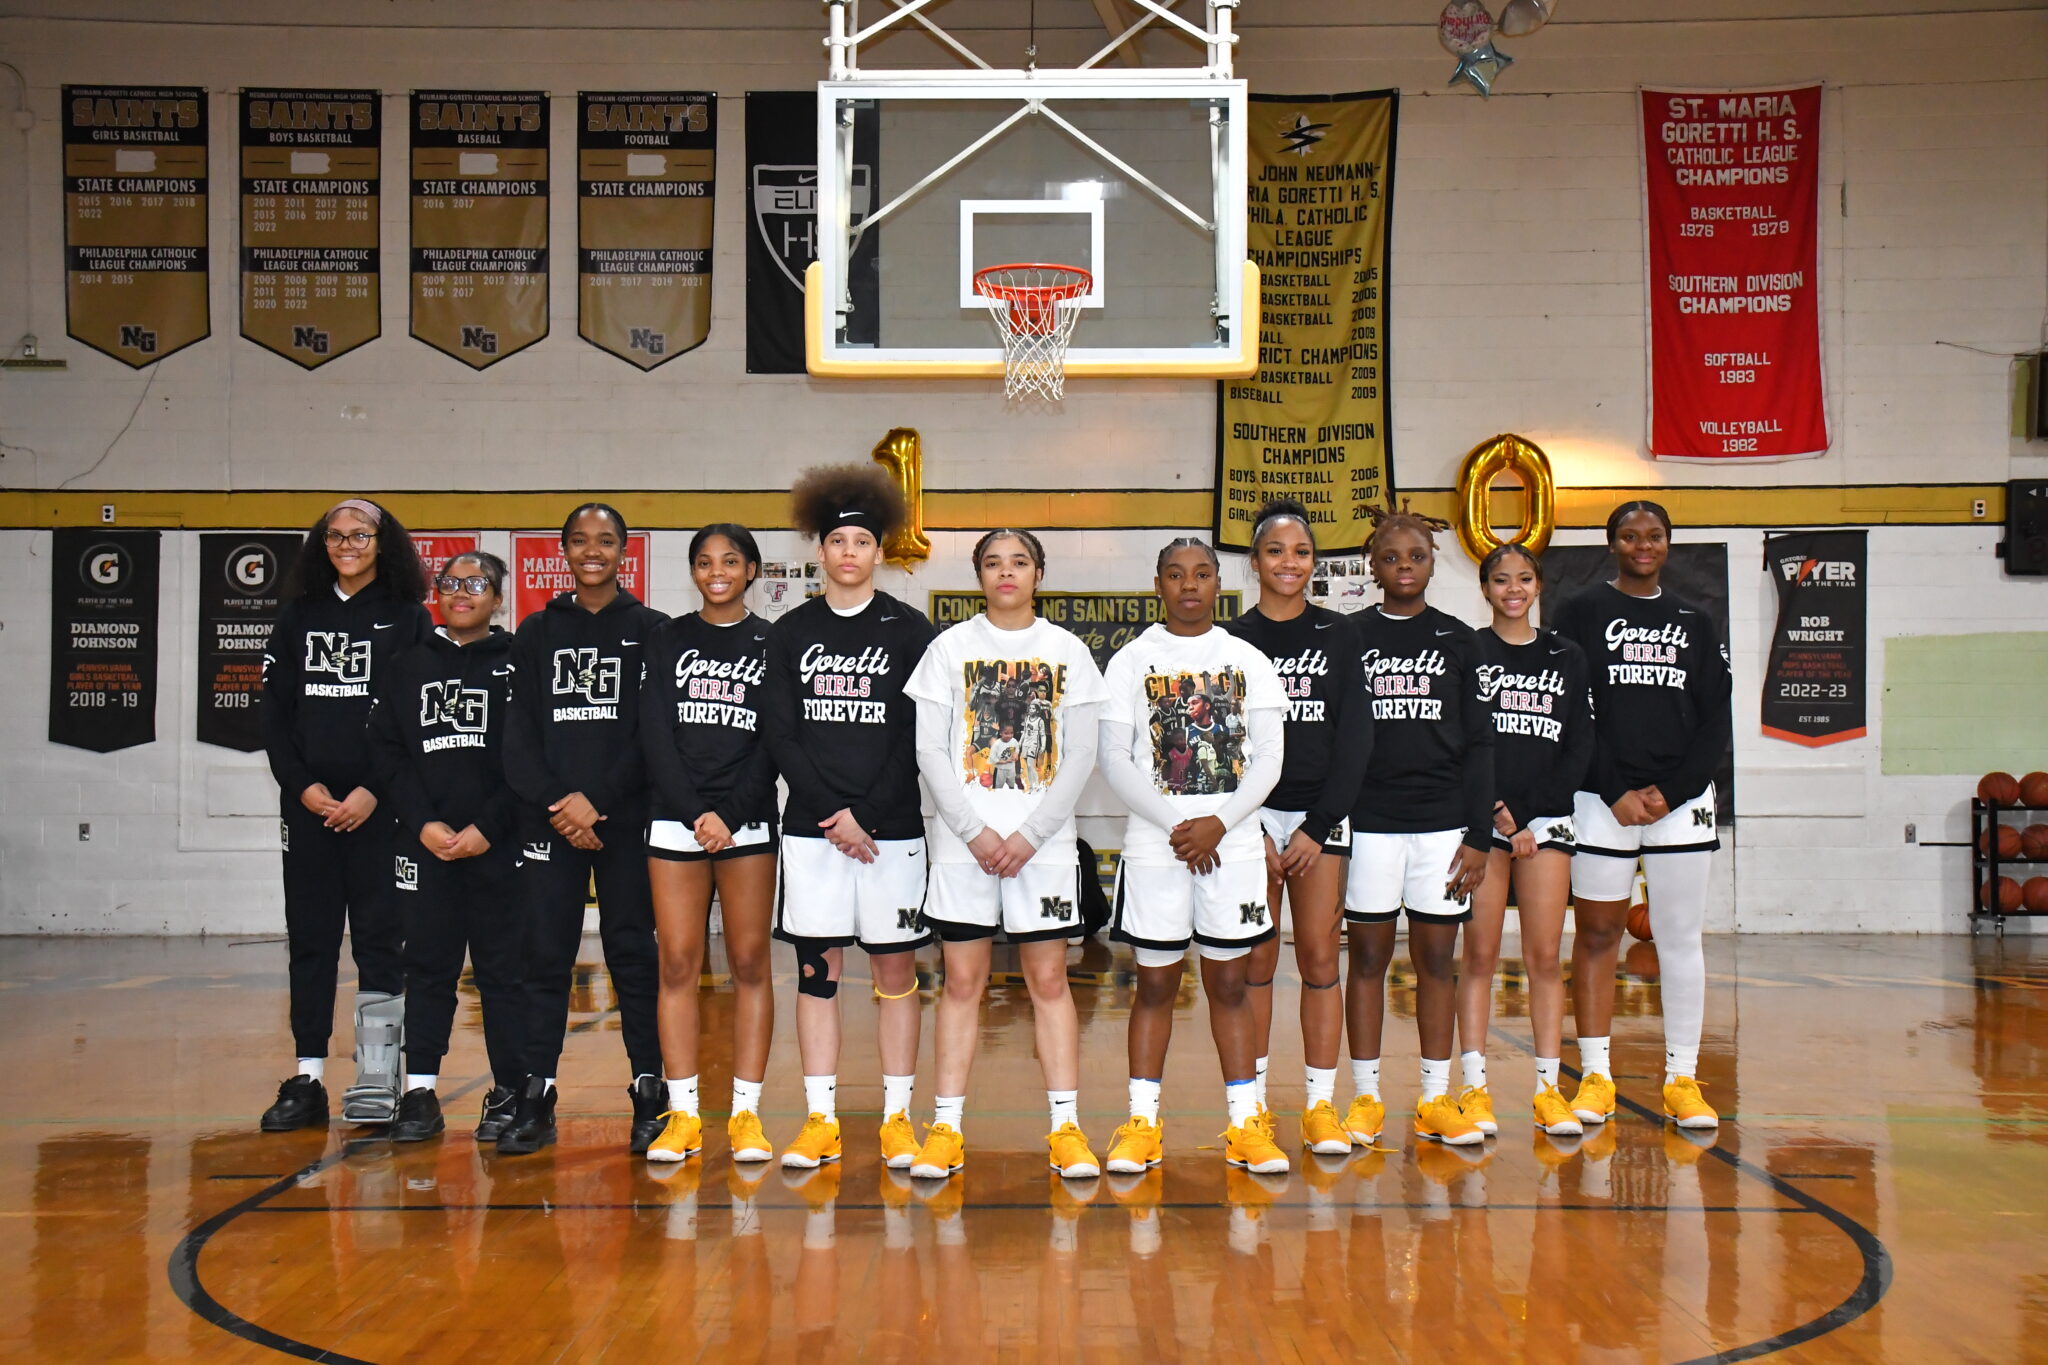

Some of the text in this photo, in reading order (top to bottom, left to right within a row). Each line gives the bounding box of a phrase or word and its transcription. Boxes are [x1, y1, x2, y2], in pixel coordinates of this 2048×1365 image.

[72, 98, 199, 128] SAINTS
[250, 101, 372, 130] SAINTS
[1668, 95, 1796, 118] ST. MARIA
[419, 103, 540, 132] SAINTS
[588, 104, 708, 132] SAINTS
[92, 131, 180, 142] GIRLS BASKETBALL
[270, 132, 352, 143] BOYS BASKETBALL
[458, 134, 501, 144] BASEBALL
[624, 135, 670, 145] FOOTBALL
[1662, 119, 1802, 144] GORETTI H. S.
[1668, 144, 1798, 164] CATHOLIC LEAGUE
[1258, 166, 1297, 182] JOHN
[1676, 166, 1788, 186] CHAMPIONS
[78, 178, 196, 192] STATE CHAMPIONS
[254, 180, 369, 194] STATE CHAMPIONS
[423, 182, 536, 194] STATE CHAMPIONS
[590, 183, 704, 196] STATE CHAMPIONS
[774, 190, 818, 209] ELI
[1248, 187, 1270, 202] RIA
[1278, 186, 1342, 204] GORETTI
[1248, 206, 1368, 226] HILA. CATHOLIC
[1690, 206, 1776, 220] BASKETBALL
[1276, 230, 1332, 246] LEAGUE
[1680, 221, 1788, 237] 1976 1978
[80, 248, 197, 259] PHILADELPHIA CATHOLIC
[254, 249, 368, 260] PHILADELPHIA CATHOLIC
[423, 250, 536, 260] PHILADELPHIA CATHOLIC
[590, 251, 704, 261] PHILADELPHIA CATHOLIC
[1248, 248, 1362, 268] CHAMPIONSHIPS
[90, 260, 187, 270] LEAGUE CHAMPIONS
[264, 261, 359, 272] LEAGUE CHAMPIONS
[432, 262, 527, 272] LEAGUE CHAMPIONS
[600, 262, 694, 272] LEAGUE CHAMPIONS
[1261, 268, 1378, 286] BASKETBALL 2005
[1668, 271, 1802, 293] SOUTHERN DIVISION
[1262, 288, 1376, 306] BASKETBALL 2006
[1680, 294, 1791, 314] CHAMPIONS
[1262, 308, 1376, 326] BASKETBALL 2009
[1352, 327, 1376, 340] 2009
[1259, 344, 1378, 364] RICT CHAMPIONS
[1704, 352, 1771, 366] SOFTBALL
[1261, 366, 1376, 384] BASKETBALL 2009
[1720, 370, 1755, 384] 1983
[1230, 386, 1376, 404] BASEBALL 2009
[1234, 423, 1374, 444] SOUTHERN DIVISION
[1700, 419, 1782, 435] VOLLEYBALL
[1722, 438, 1758, 452] 1982
[1263, 446, 1345, 464] CHAMPIONS
[1230, 466, 1378, 484] BOYS BASKETBALL 2006
[1230, 488, 1256, 502] BOYS
[1352, 485, 1379, 500] 2007
[1228, 508, 1252, 522] GIRL
[90, 553, 119, 584] G
[236, 554, 264, 586] G
[1042, 598, 1140, 622] NG SAINTS
[71, 623, 140, 634] DIAMOND
[216, 624, 274, 636] DIAMON
[1800, 616, 1830, 628] ROB
[72, 638, 138, 648] JOHNSON
[1605, 618, 1690, 651] Goretti
[1788, 630, 1844, 642] WRIGHT
[218, 638, 268, 650] JOHNS
[305, 632, 372, 684] NG
[1273, 648, 1328, 676] retti
[1623, 643, 1676, 664] GIRLS
[676, 648, 762, 688] Goretti
[800, 644, 890, 684] Goretti
[553, 648, 621, 704] NG
[1608, 665, 1686, 690] FOREVER
[305, 684, 369, 697] BASKETBALL
[688, 678, 746, 704] GIRLS
[814, 674, 872, 698] GIRLS
[1374, 675, 1430, 696] GIRLS
[1780, 684, 1846, 698] 2022-23
[70, 692, 106, 707] 2018
[122, 692, 138, 708] 19
[214, 693, 249, 708] 2019
[420, 679, 488, 732] NG
[1372, 698, 1442, 720] OREVER
[1500, 690, 1553, 714] GIRLS
[553, 706, 618, 722] BASKETBALL
[677, 701, 757, 732] FOREVER
[803, 698, 886, 724] FOREVER
[422, 734, 486, 753] BASKETBALL
[1040, 896, 1072, 922] NG
